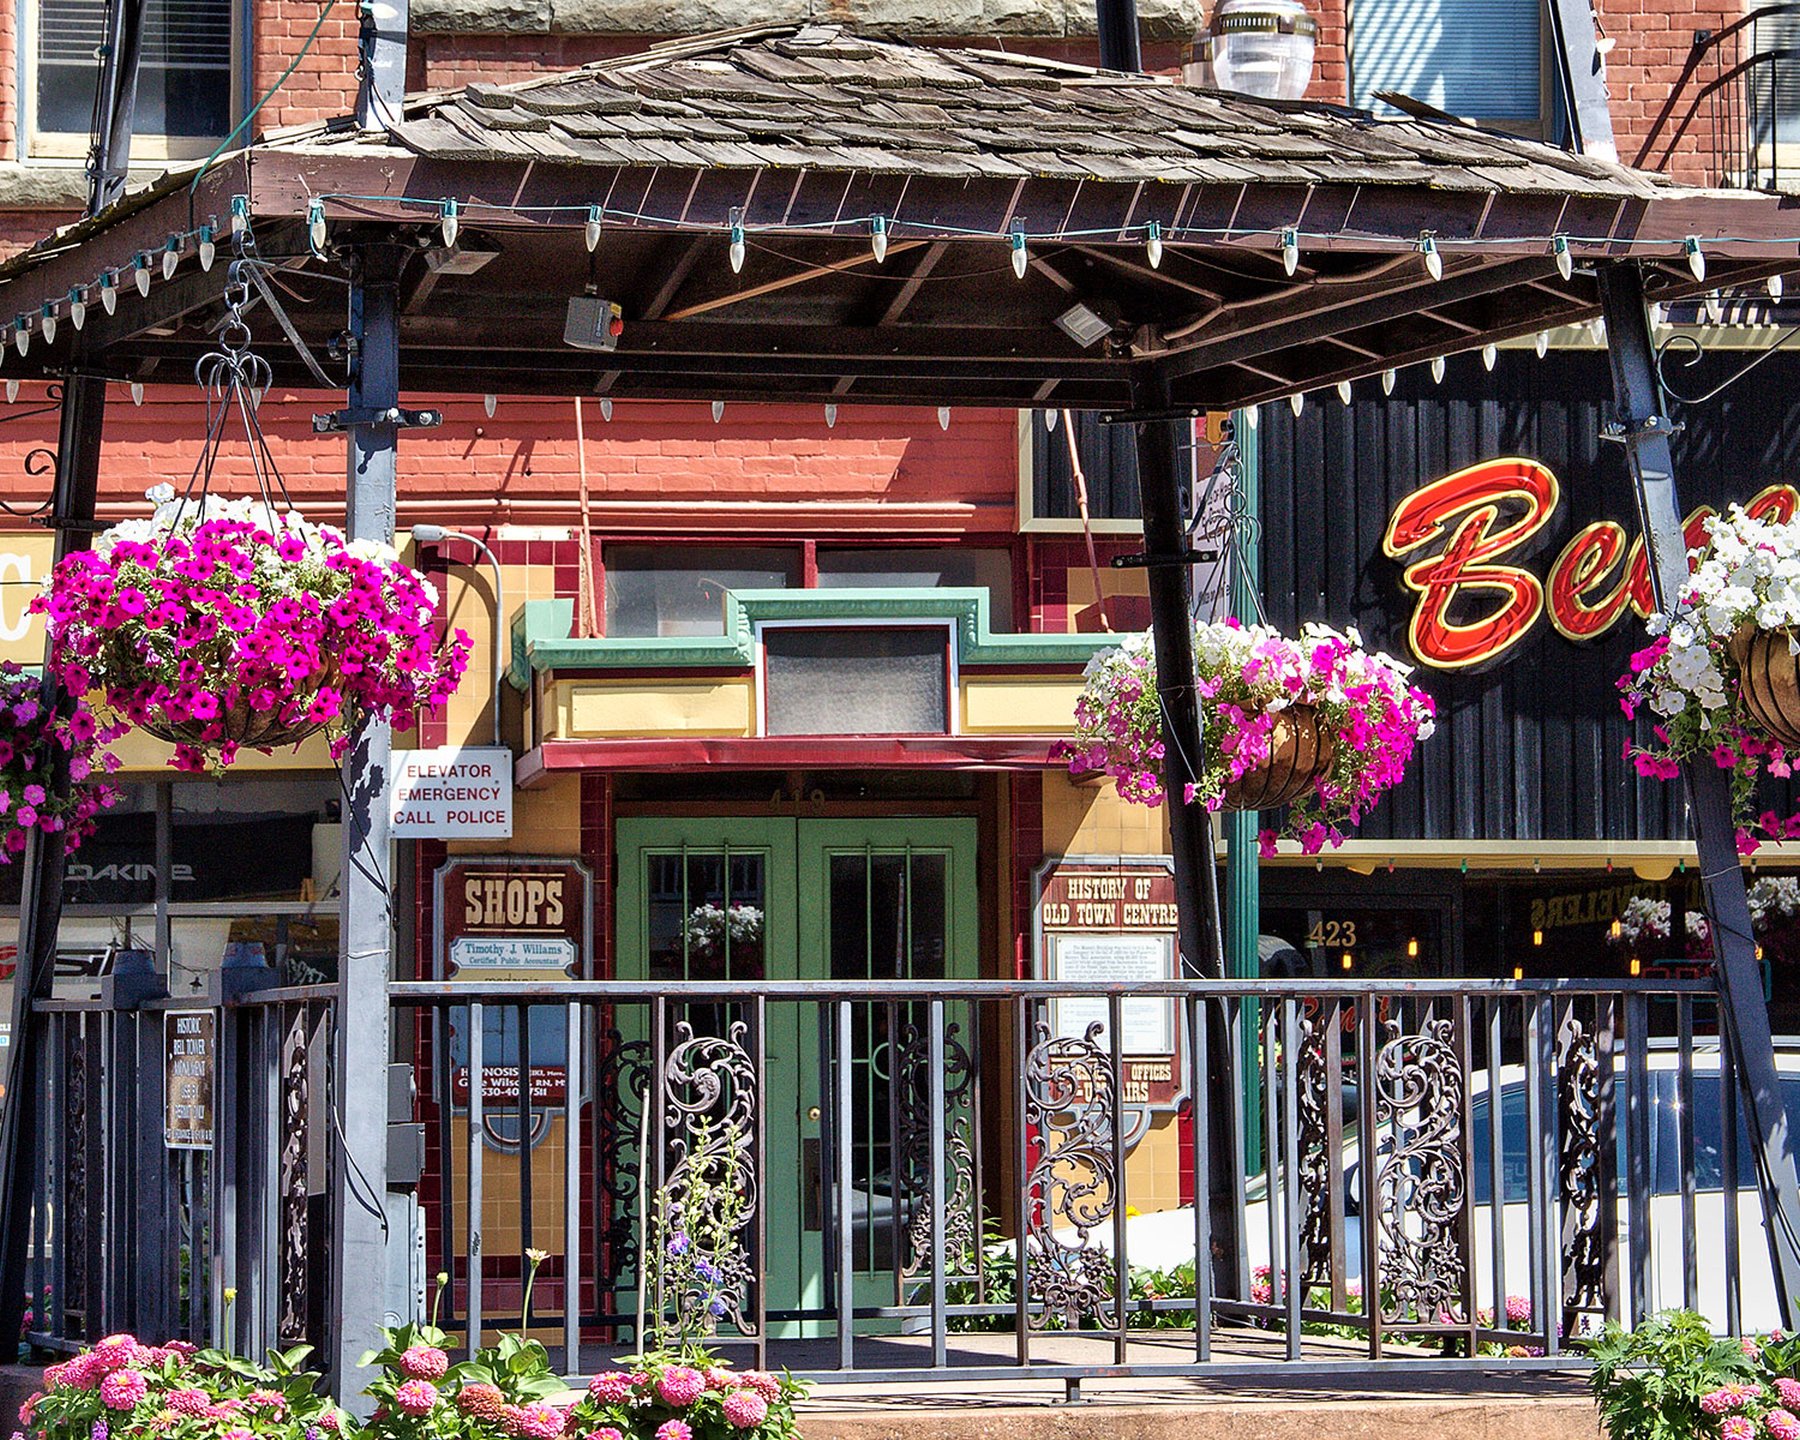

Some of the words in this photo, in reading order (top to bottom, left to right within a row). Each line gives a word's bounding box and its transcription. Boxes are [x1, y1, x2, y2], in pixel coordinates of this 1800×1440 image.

[407, 765, 492, 778] ELEVATOR
[398, 787, 501, 801] EMERGENCY
[394, 811, 436, 824] CALL
[447, 811, 506, 824] POLICE
[1068, 878, 1127, 900] HISTORY
[1135, 878, 1152, 900] OF
[465, 879, 564, 925] SHOPS
[1043, 903, 1070, 924] OLD
[1077, 903, 1116, 925] TOWN
[1123, 903, 1178, 925] CENTRE
[1309, 920, 1357, 947] 423
[465, 943, 504, 956] Timothy
[461, 1067, 519, 1077] HNOSIS
[1132, 1064, 1172, 1081] OFFICES
